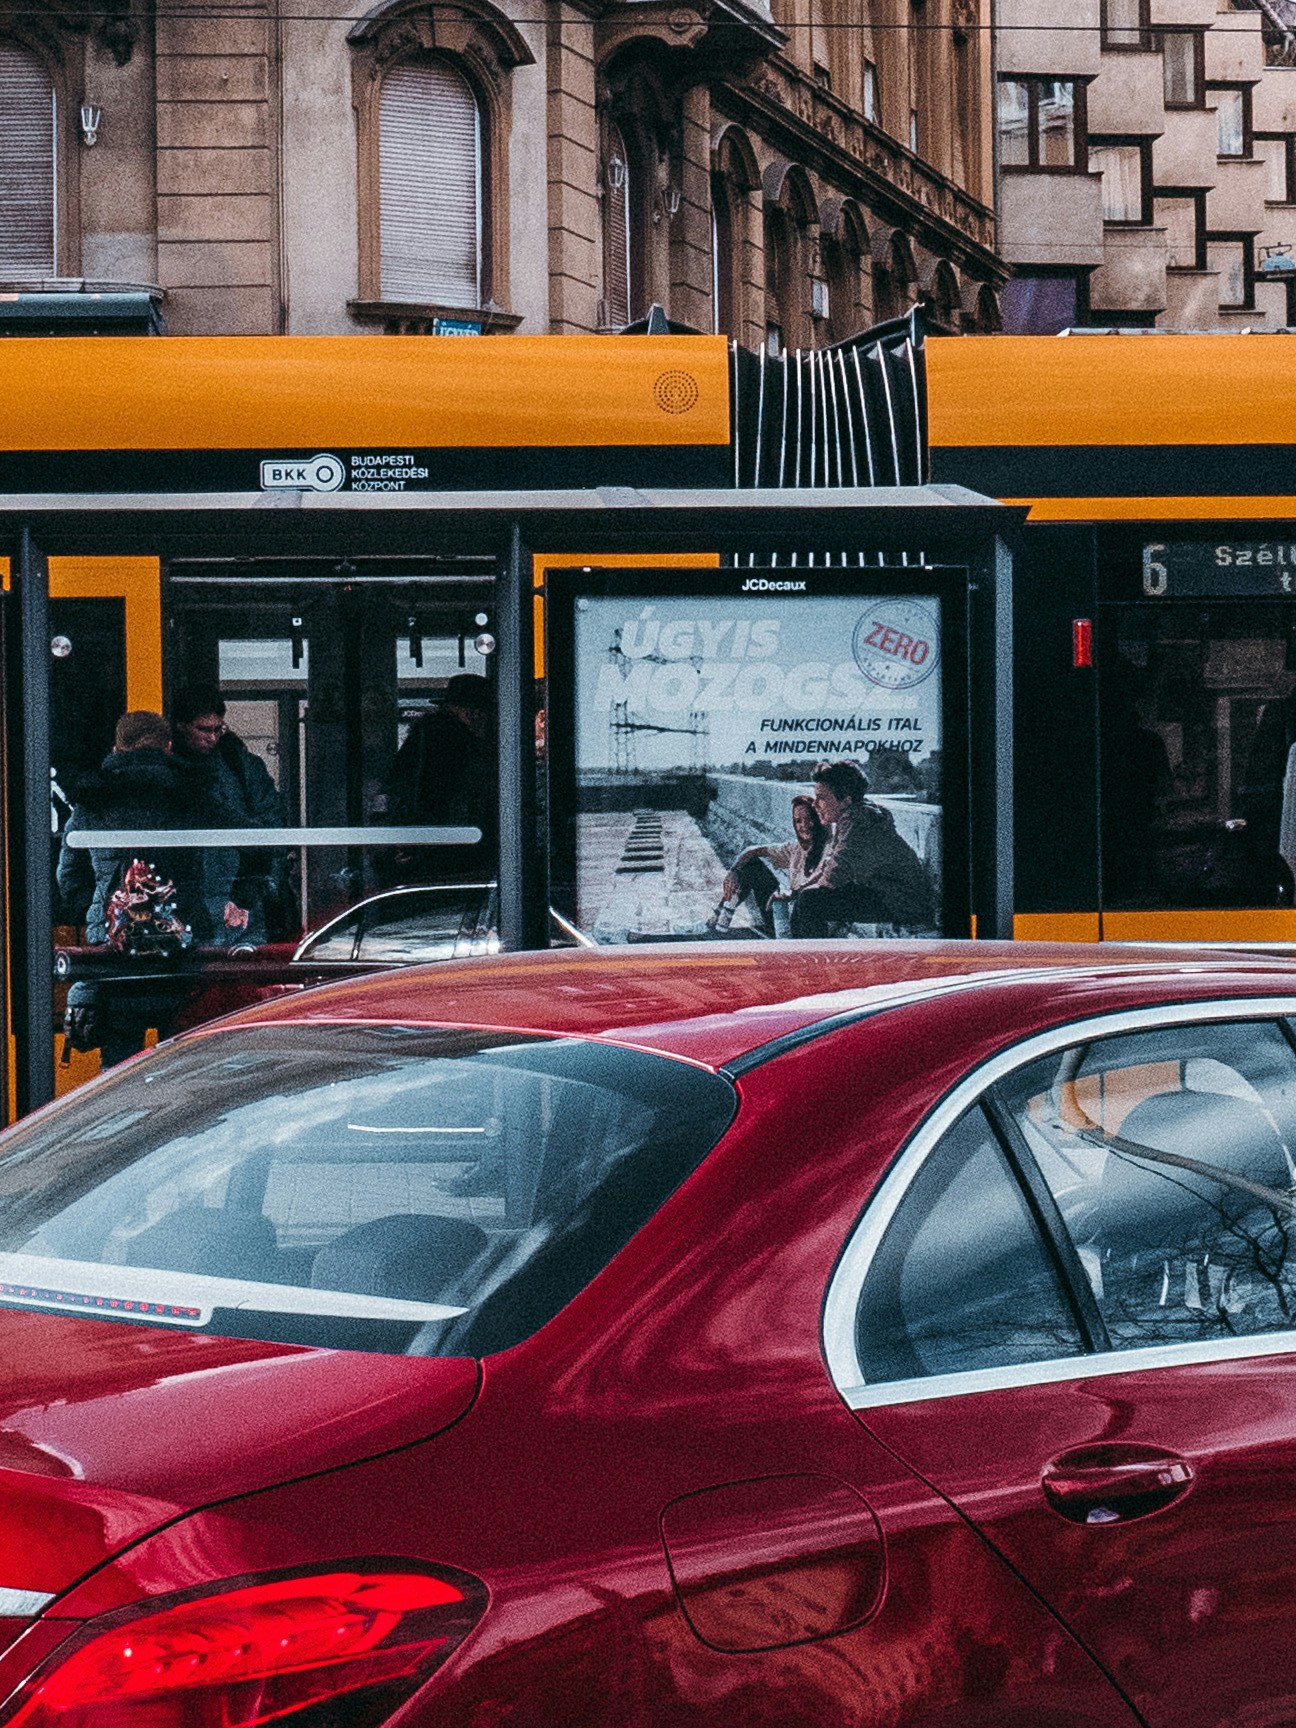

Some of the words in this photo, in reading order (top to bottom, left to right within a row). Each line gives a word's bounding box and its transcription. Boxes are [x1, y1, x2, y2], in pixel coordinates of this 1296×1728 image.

[351, 455, 415, 467] BUDAPESTI
[272, 468, 306, 481] BKK
[351, 466, 429, 479] KÖZLEKEDÉSI
[351, 479, 406, 492] KÖZPONT
[1141, 542, 1169, 596] 6
[741, 578, 806, 591] JCDecaux
[863, 622, 930, 665] ZERO
[760, 714, 882, 732] FUNKCIONÁLIS
[887, 717, 922, 731] ITAL
[745, 740, 757, 754] A
[763, 739, 924, 755] MINDENNAPOKHOZ
